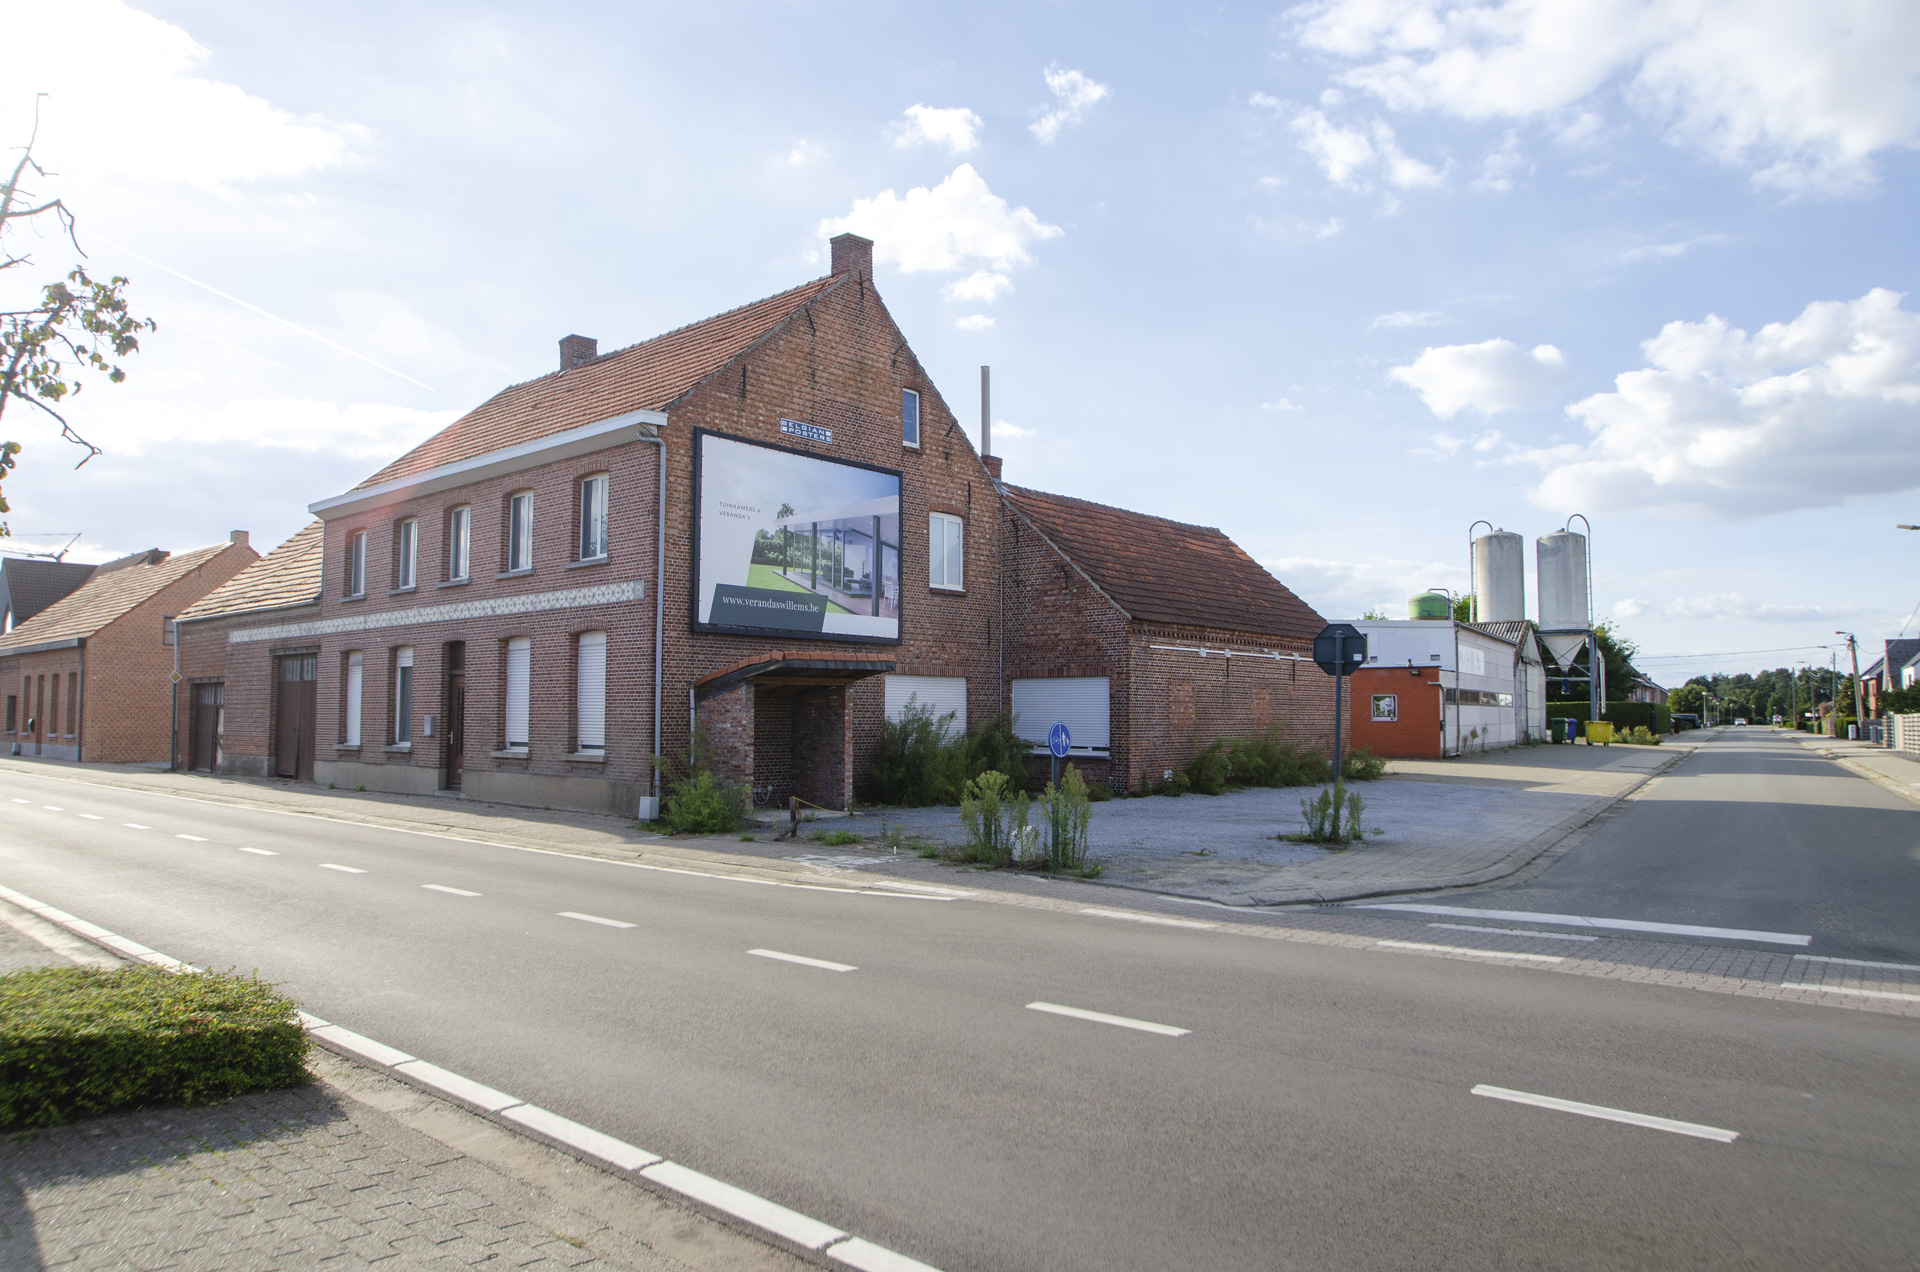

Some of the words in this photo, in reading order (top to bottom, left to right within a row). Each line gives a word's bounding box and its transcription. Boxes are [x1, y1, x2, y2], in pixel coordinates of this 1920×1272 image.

[781, 420, 825, 435] BELGIAN
[788, 427, 832, 442] POSTERS
[719, 501, 756, 513] TUINKAMERS
[718, 510, 751, 521] VERANDA'S
[722, 596, 819, 613] www.verandaswillems.be
